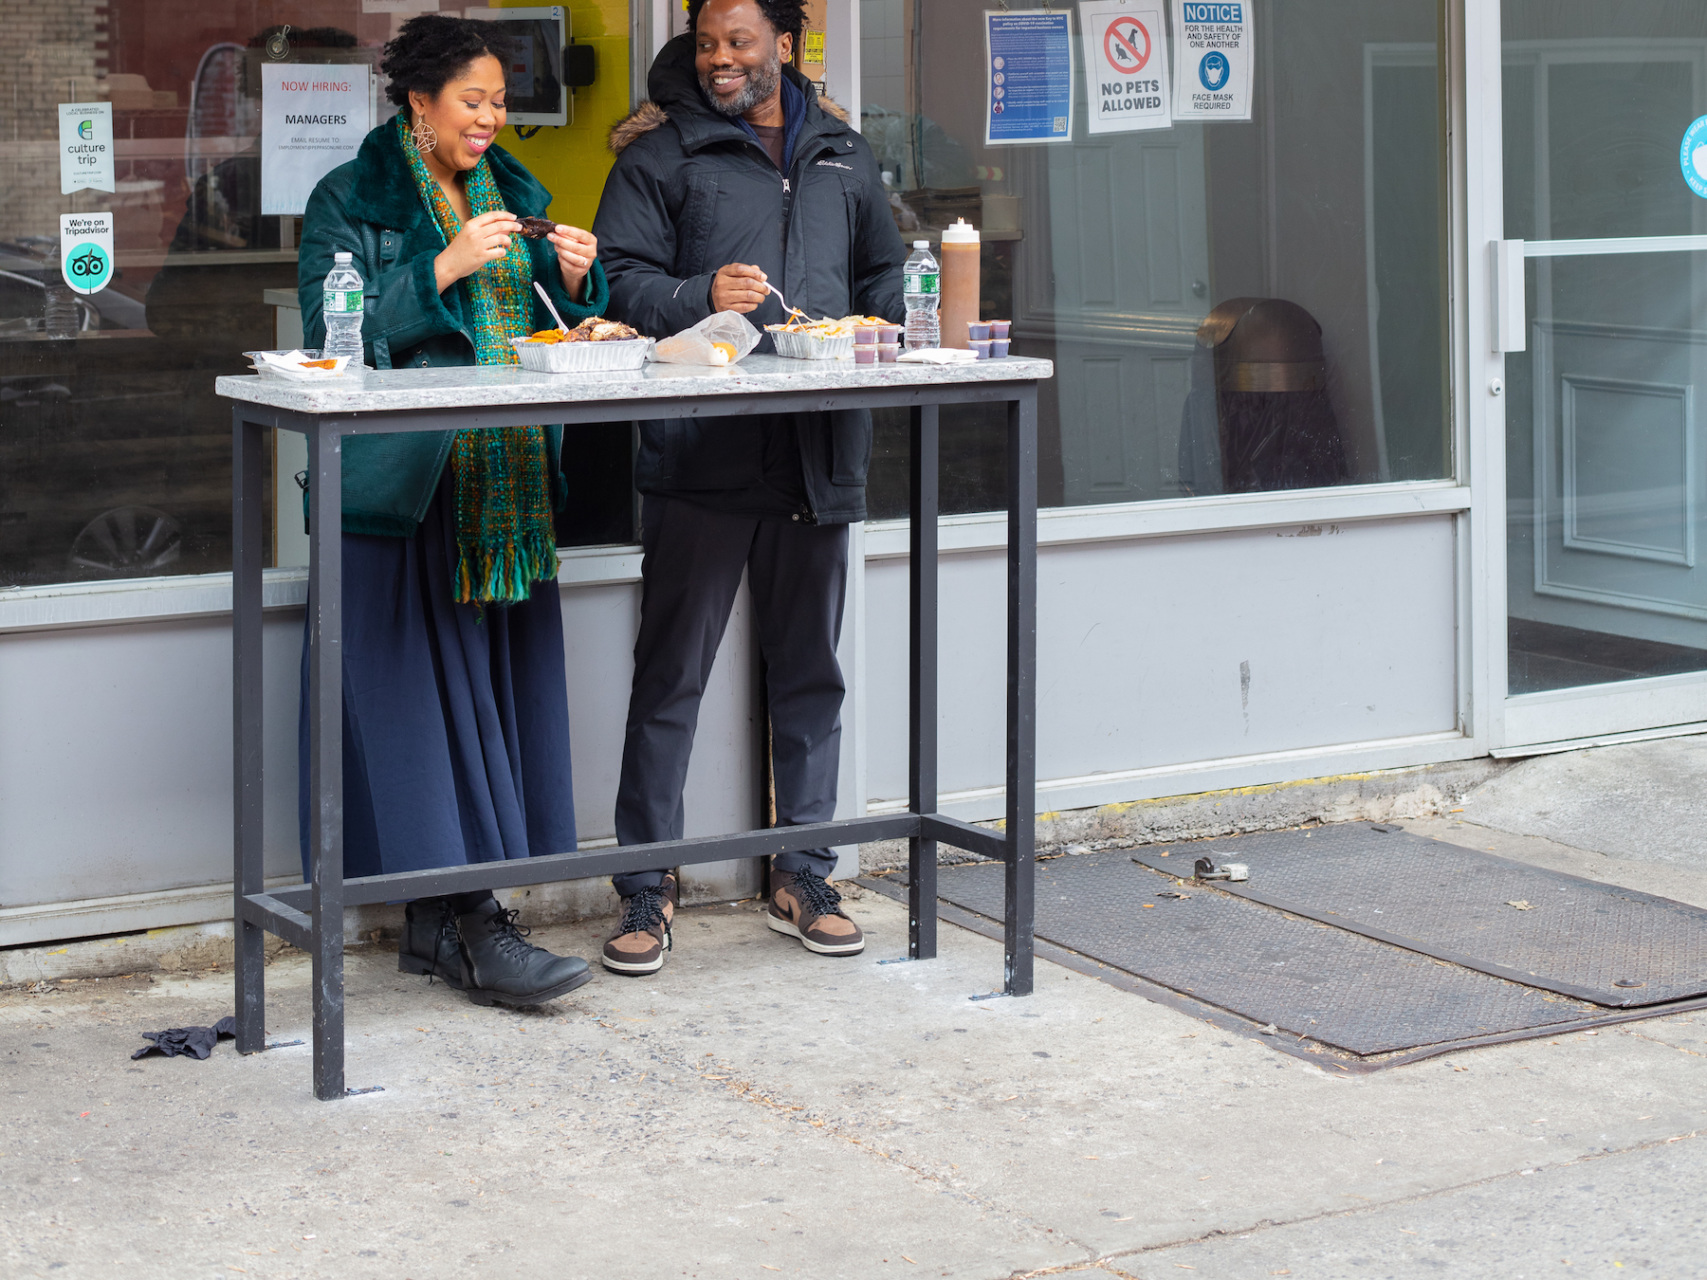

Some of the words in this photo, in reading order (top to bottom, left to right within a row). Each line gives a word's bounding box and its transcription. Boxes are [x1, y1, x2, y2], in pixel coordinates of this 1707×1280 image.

[1186, 4, 1240, 21] NOTICE
[1185, 25, 1200, 33] FOR
[1201, 25, 1215, 33] THE
[1216, 25, 1243, 33] HEALTH
[1206, 41, 1240, 49] ANOTHER
[281, 81, 309, 92] NOW
[312, 81, 352, 92] HIRING:
[1101, 82, 1123, 96] NO
[1126, 80, 1160, 94] PETS
[1102, 96, 1161, 113] ALLOWED
[1193, 102, 1231, 110] REQUIRED
[285, 115, 347, 125] MANAGERS
[1689, 120, 1705, 137] WEAR
[67, 144, 106, 154] culture
[1683, 135, 1693, 166] PLEASE
[78, 154, 97, 166] trip
[1688, 176, 1704, 192] KEEP
[69, 219, 92, 227] We're
[65, 226, 109, 237] Tripadvisor
